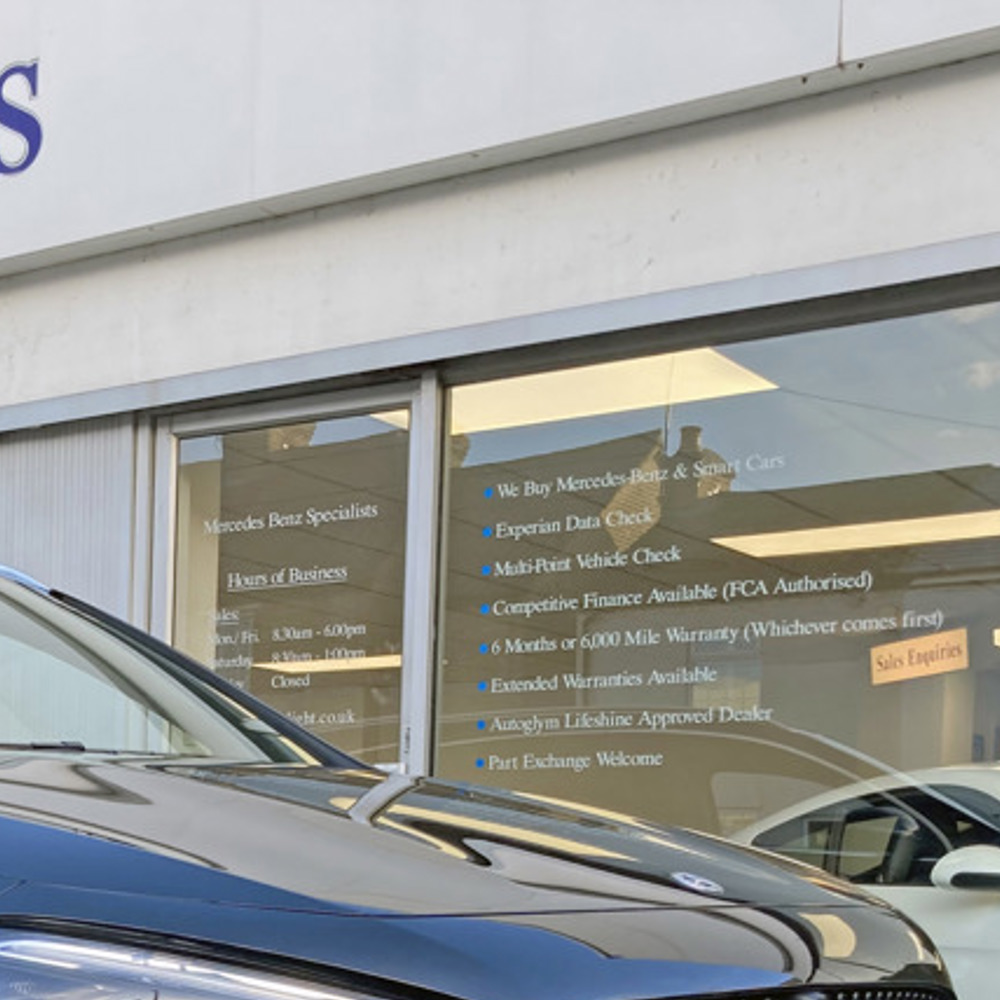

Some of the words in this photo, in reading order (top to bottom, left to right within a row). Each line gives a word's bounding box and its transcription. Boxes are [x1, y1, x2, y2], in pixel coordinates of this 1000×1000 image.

[497, 483, 519, 499] We
[524, 481, 552, 499] Buy
[556, 469, 669, 493] Mercedes-Benz
[673, 464, 688, 480] &
[693, 458, 740, 478] Smart
[746, 453, 785, 471] Cars
[203, 515, 265, 536] Mercedes
[268, 511, 303, 529] Benz
[306, 503, 379, 528] Specialists
[496, 520, 561, 541] Experian
[565, 515, 600, 533] Data
[605, 508, 654, 528] Check
[494, 557, 571, 578] Multi-Point
[577, 551, 629, 569] Vehicle
[632, 545, 682, 563] Check
[227, 572, 268, 590] Hours
[271, 568, 286, 585] of
[289, 566, 348, 583] Business
[492, 596, 578, 618] Competitive
[582, 592, 643, 609] Finance
[646, 583, 717, 603] Available
[722, 579, 768, 601] (FCA
[773, 570, 873, 594] Authorised)
[491, 640, 501, 655] 6
[505, 635, 558, 654] Months
[561, 636, 576, 650] or
[580, 631, 622, 651] 6,000
[624, 629, 661, 647] Mile
[666, 625, 739, 644] Warranty
[743, 619, 836, 642] (Whichever
[842, 615, 897, 632] comes
[902, 610, 944, 629] first)
[875, 654, 904, 673] Sales
[908, 642, 963, 668] Enquiries
[271, 673, 310, 689] Closed
[491, 674, 558, 694] Extended
[562, 669, 643, 690] Warranties
[647, 665, 718, 685] Available
[489, 715, 560, 735] Autoglym
[565, 710, 633, 729] Lifeshine
[637, 706, 714, 729] Approved
[719, 704, 773, 722] Dealer
[488, 754, 518, 771] Part
[523, 753, 591, 772] Exchange
[597, 750, 664, 768] Welcome
